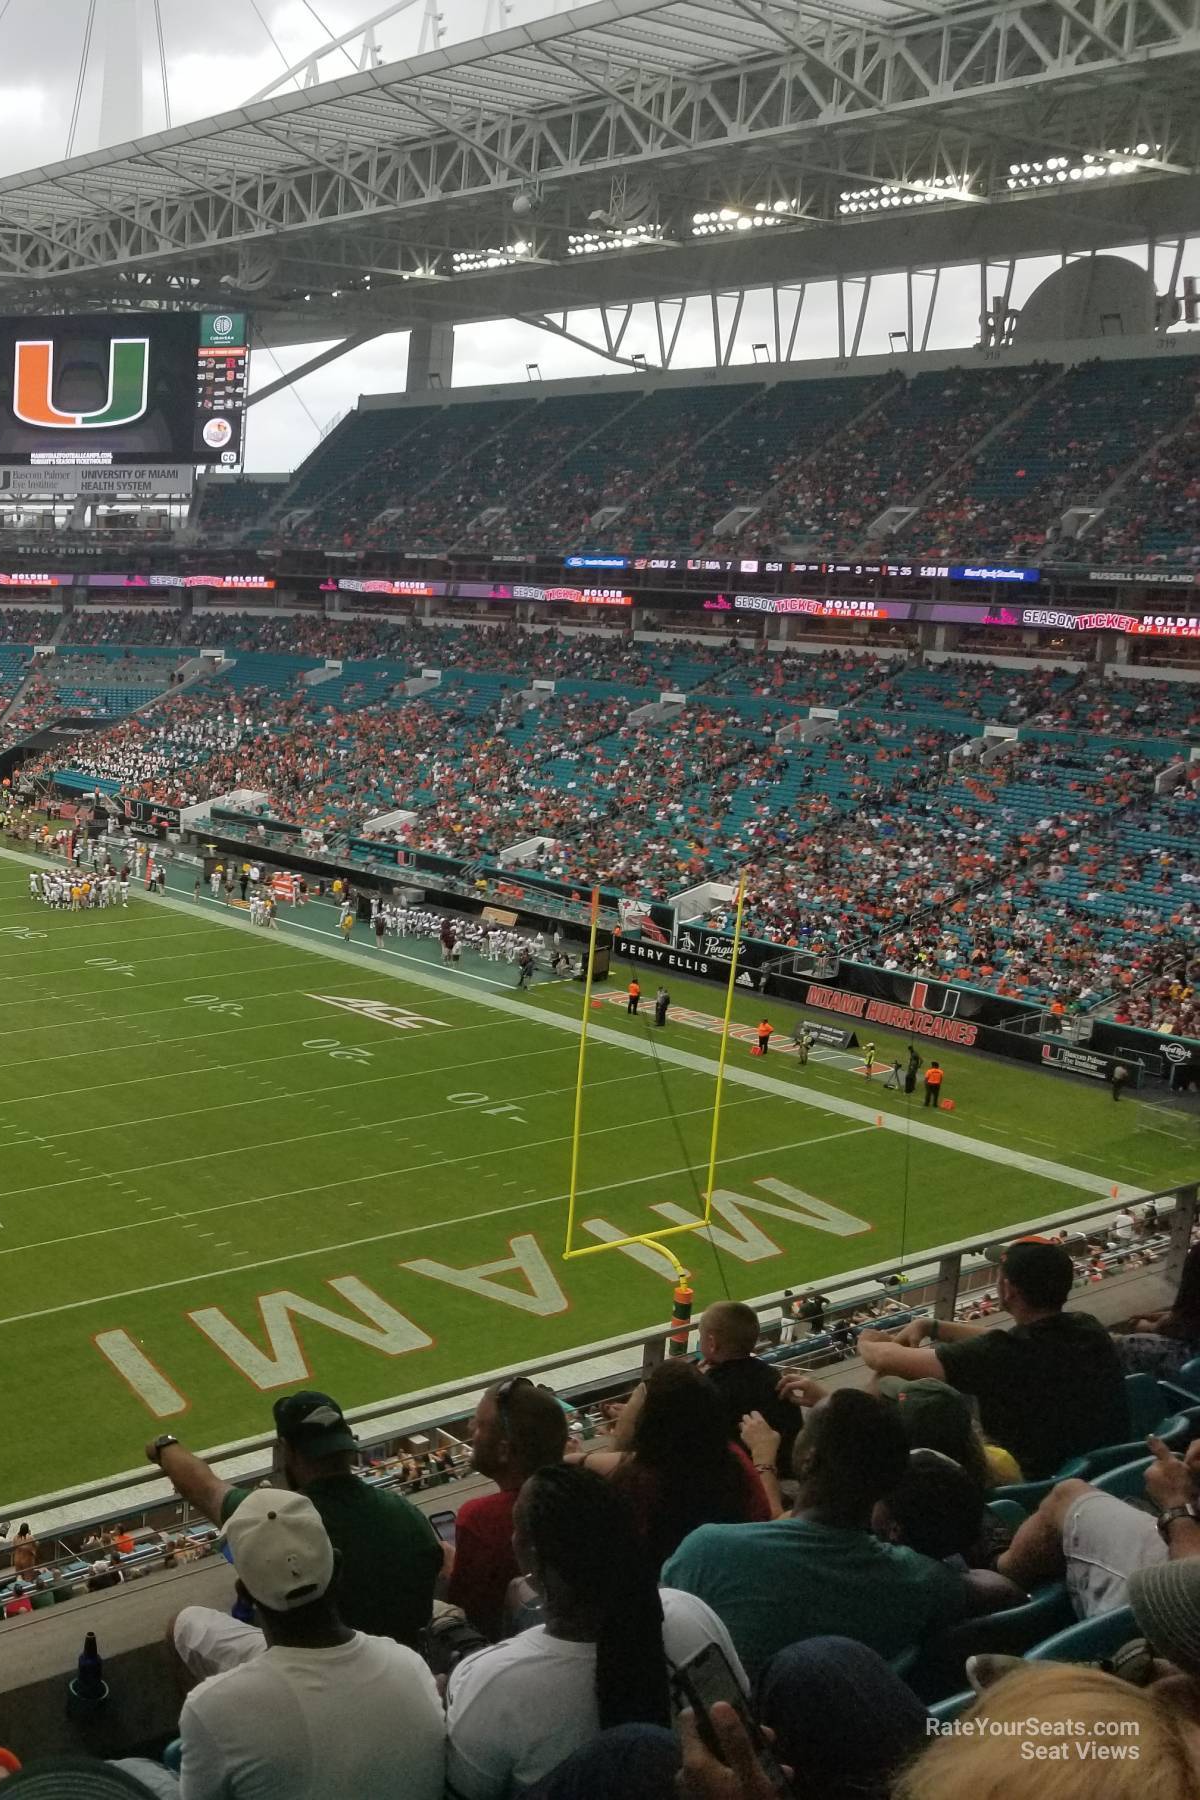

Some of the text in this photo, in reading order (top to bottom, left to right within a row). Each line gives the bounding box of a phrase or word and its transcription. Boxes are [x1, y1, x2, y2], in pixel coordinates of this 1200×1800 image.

[13, 471, 71, 480] Bascom Palmer
[81, 470, 178, 479] UNIVERSITY OF MIAMI
[13, 480, 56, 489] Eye Institute
[81, 482, 151, 490] HEALTH SYSTEM
[670, 560, 677, 568] 2
[726, 562, 732, 570] 7
[855, 566, 862, 574] 3
[900, 567, 912, 576] 35
[1090, 571, 1194, 583] RUSSELL MARYLAND
[735, 595, 776, 611] SEASON
[775, 598, 822, 613] TICKET
[826, 600, 875, 610] HOLDER
[1023, 609, 1077, 629] SEASON
[1076, 612, 1139, 632] TICKET
[1143, 616, 1200, 627] HOLDE
[1138, 625, 1152, 633] OF
[1158, 626, 1177, 634] THE
[0, 926, 47, 940] 50
[620, 943, 708, 975] PERRY ELLIS
[85, 957, 137, 976] 40
[184, 994, 244, 1015] 30
[805, 985, 867, 1018] MIAMI
[866, 1000, 978, 1046] HURRICANES
[302, 1038, 375, 1060] 20
[1159, 1044, 1176, 1054] Hard
[1176, 1047, 1192, 1058] Rock
[446, 1092, 526, 1117] 10
[93, 1177, 873, 1418] MIAMI
